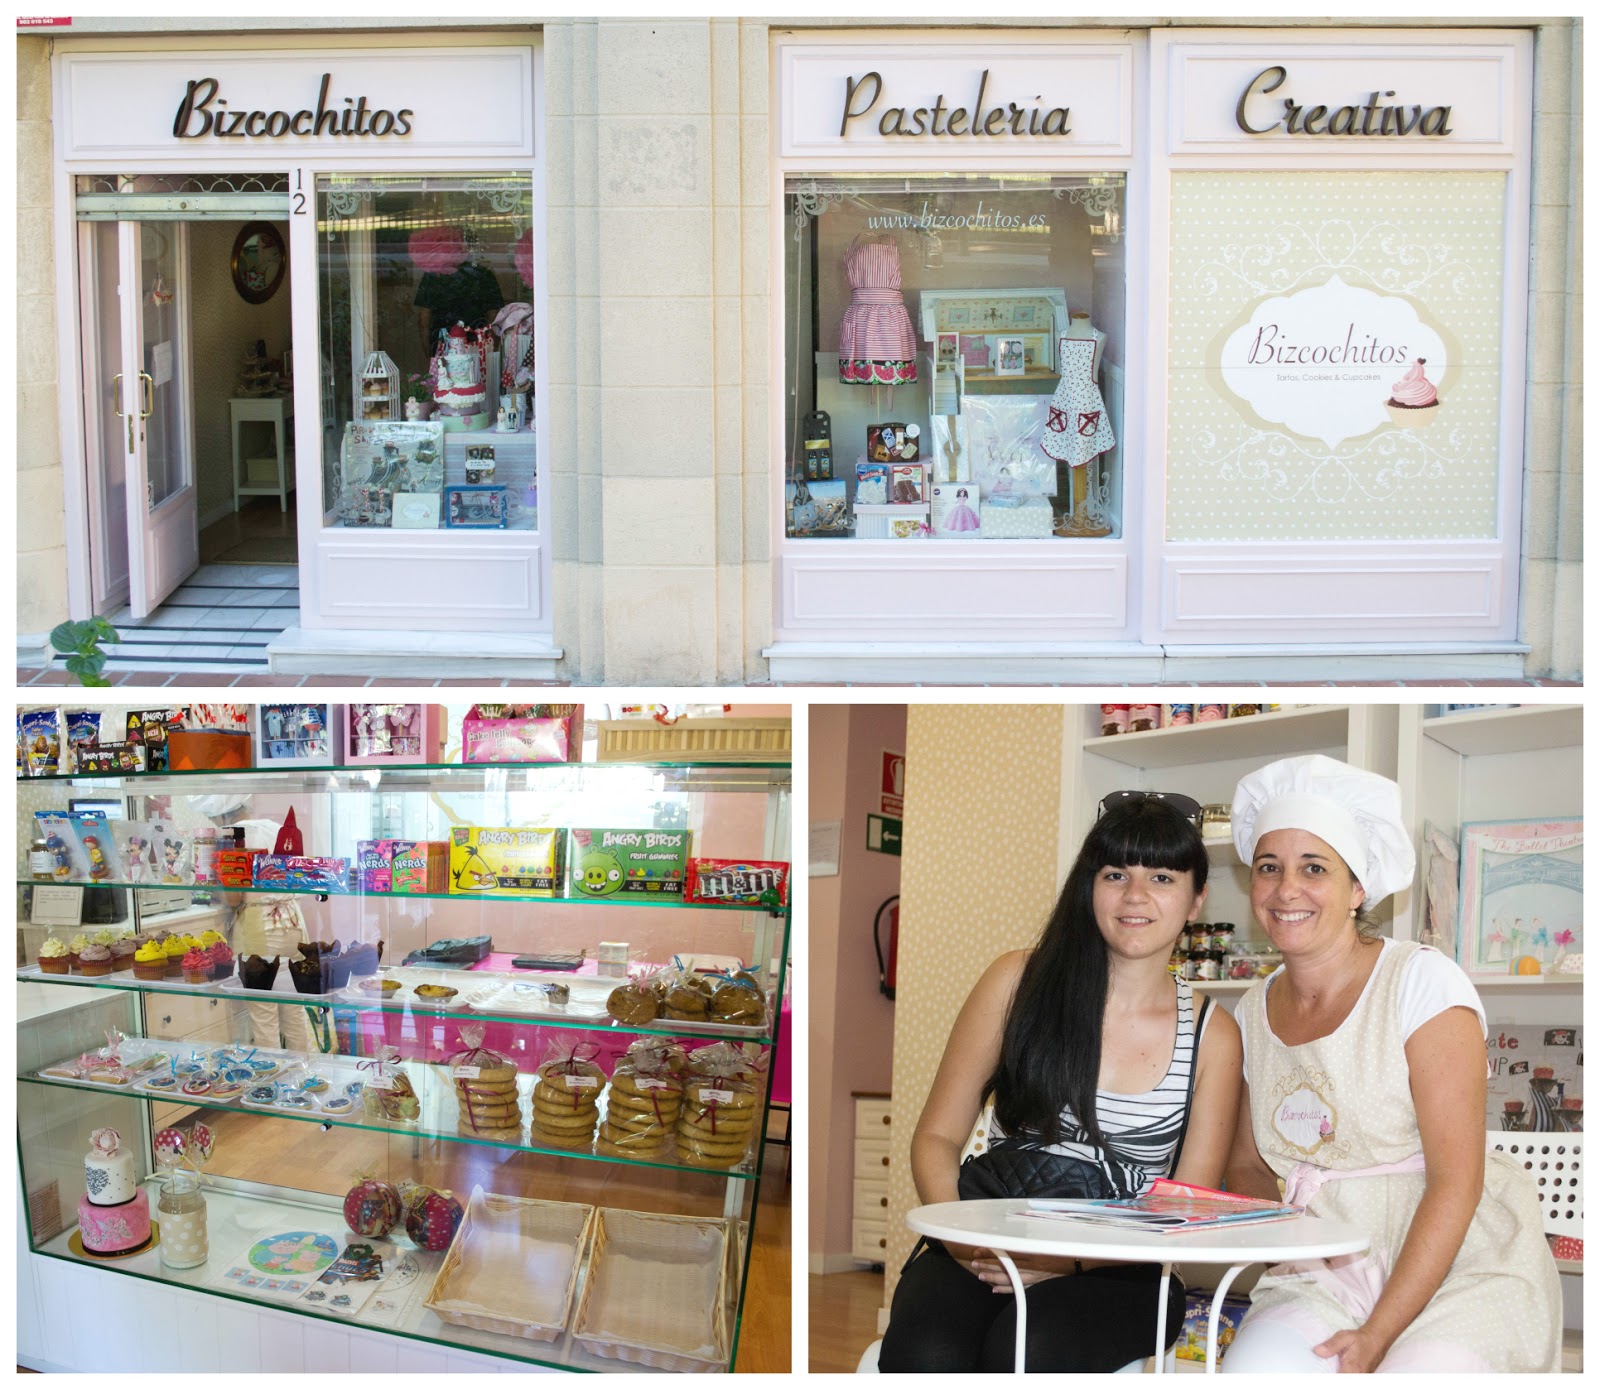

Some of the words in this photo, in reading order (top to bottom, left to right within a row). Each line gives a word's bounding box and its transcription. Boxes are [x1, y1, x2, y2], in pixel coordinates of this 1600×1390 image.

[172, 73, 414, 139] Bizcochitos
[1234, 65, 1453, 137] Creativa
[868, 200, 1047, 230] www.bizcochitos.es
[1247, 322, 1408, 365] Bizcochitos
[1302, 373, 1333, 382] Cookies
[1334, 373, 1341, 382] &
[1342, 373, 1382, 383] Cupcakes
[141, 711, 165, 723] ANGRY
[467, 731, 489, 741] Cake
[478, 830, 516, 846] ANGRY
[602, 831, 642, 848] ANGRY
[643, 832, 682, 848] BIRDS
[629, 852, 648, 860] FRUIT
[648, 853, 679, 861] GUMMIES
[1184, 1303, 1235, 1329] apri-Snne
